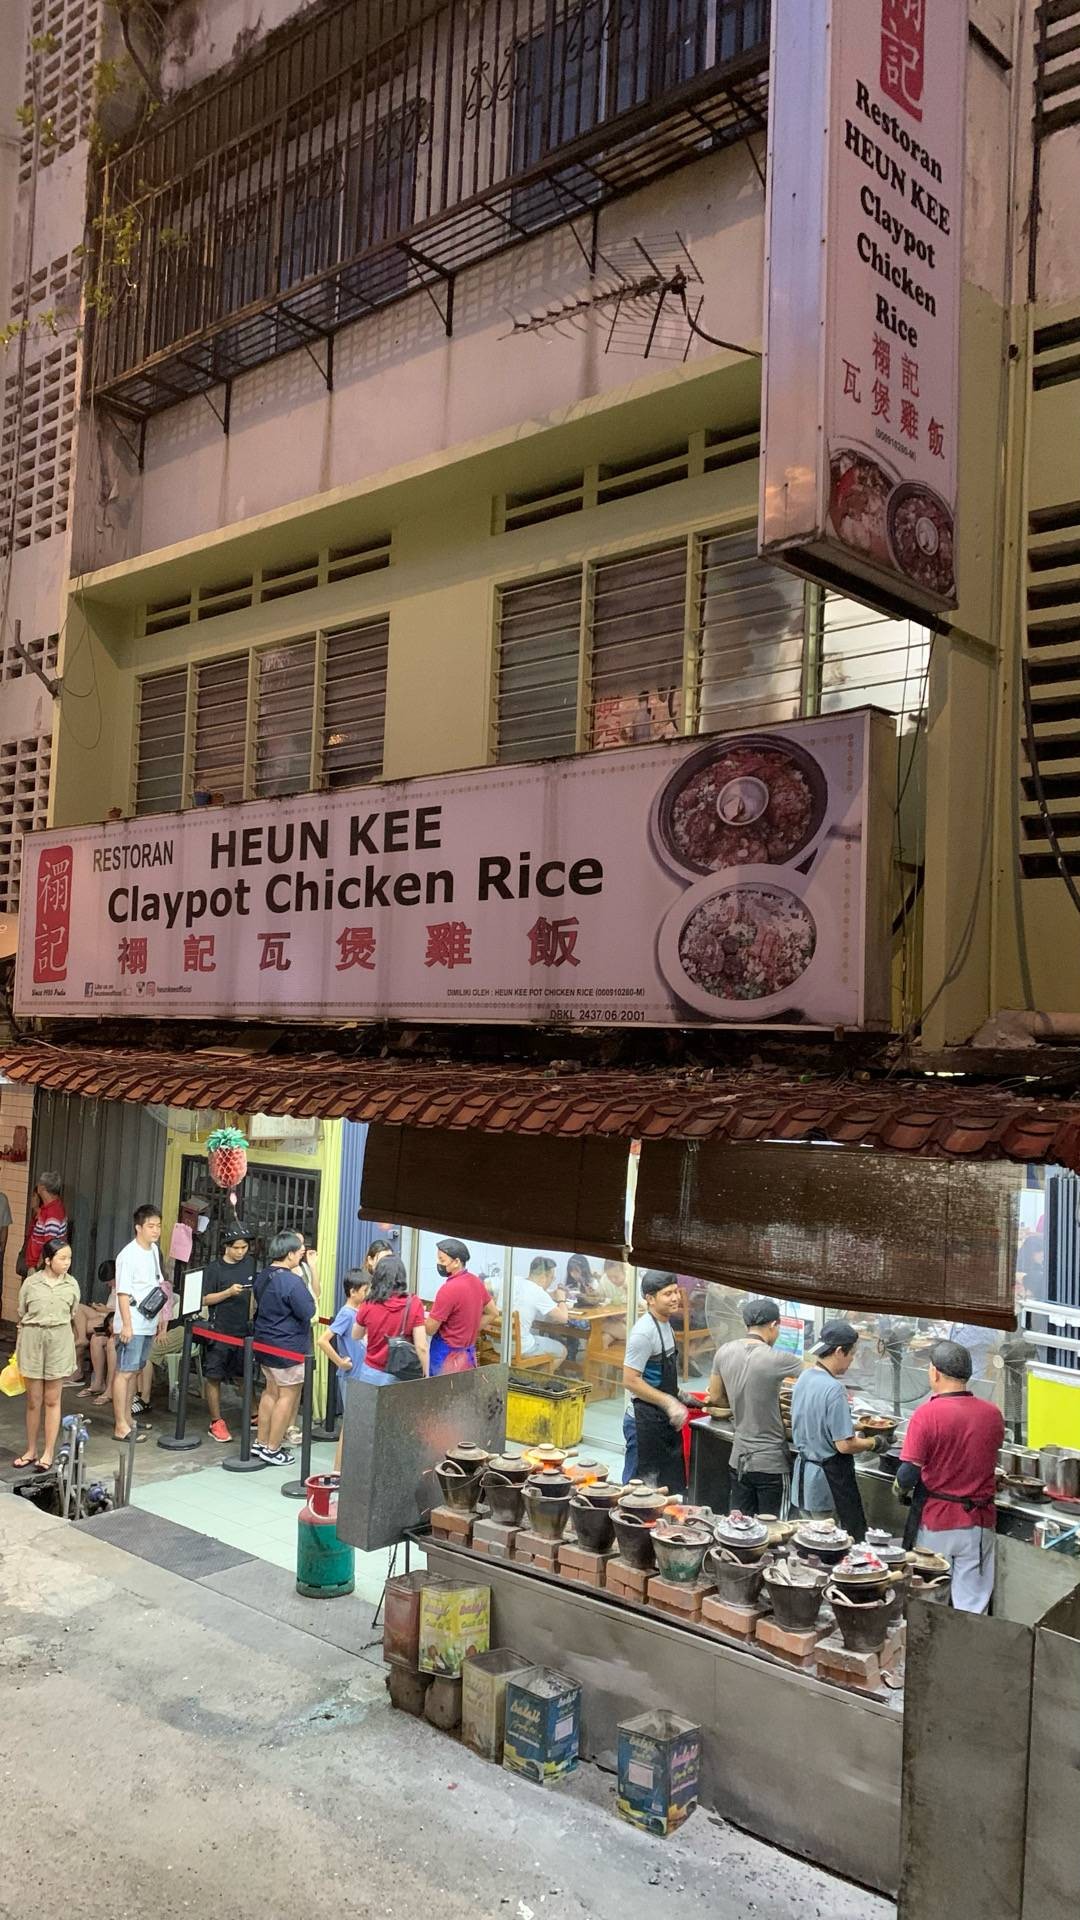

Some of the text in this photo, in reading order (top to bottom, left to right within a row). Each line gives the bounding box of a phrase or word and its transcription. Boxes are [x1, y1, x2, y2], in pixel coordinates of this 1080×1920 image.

[855, 78, 943, 184] Restoran
[843, 118, 951, 236] HEUN KEE
[860, 185, 936, 269] Claypot
[856, 231, 937, 317] Chicken
[875, 292, 918, 348] Rice
[92, 805, 443, 874] RESTORAN HEUN KEE
[108, 851, 604, 929] Claypot Chicken Rice
[472, 988, 490, 997] OLEH
[494, 988, 513, 997] HEUN
[514, 988, 528, 997] KEE
[529, 988, 542, 997] POT
[544, 988, 575, 997] CHICKEN
[576, 988, 593, 997] RICE
[550, 1010, 576, 1020] DBKL
